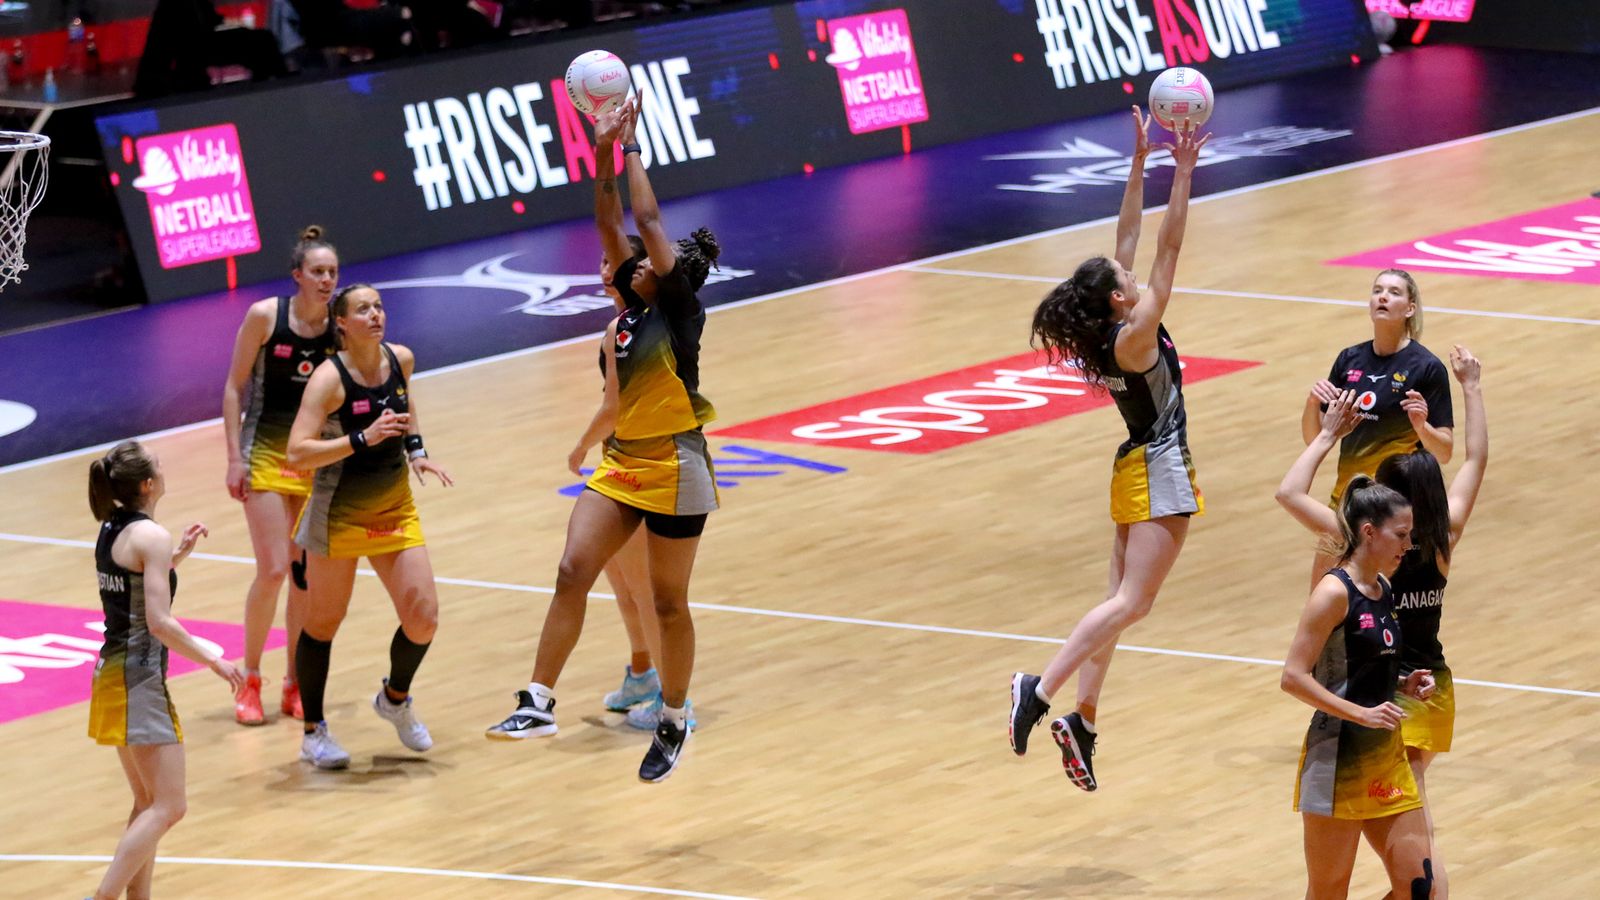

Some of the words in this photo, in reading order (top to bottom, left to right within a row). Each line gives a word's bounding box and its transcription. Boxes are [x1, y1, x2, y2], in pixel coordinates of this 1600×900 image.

[856, 17, 912, 65] Vitality
[600, 70, 622, 83] Vitality
[842, 67, 920, 106] NETBALL
[849, 96, 925, 129] SUPERLEAGUE
[173, 134, 242, 188] Vitality
[154, 190, 251, 237] NETBALL
[161, 224, 257, 263] SUPERLEAGUE
[791, 357, 1187, 444] sport
[1391, 588, 1444, 610] LANAGA
